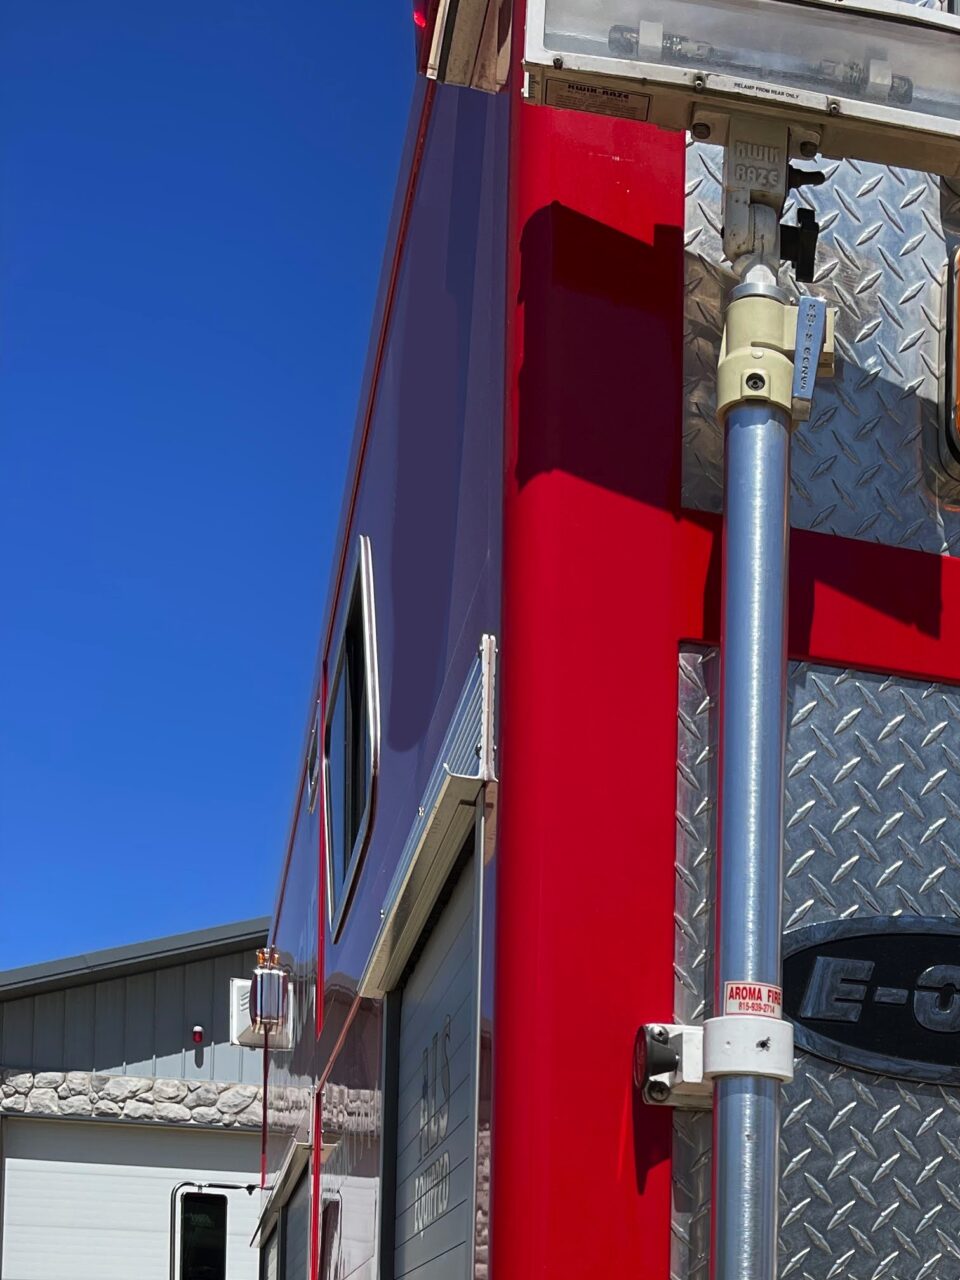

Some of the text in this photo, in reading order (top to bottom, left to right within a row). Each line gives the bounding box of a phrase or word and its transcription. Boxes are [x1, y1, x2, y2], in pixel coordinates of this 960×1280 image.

[735, 140, 780, 163] KWIK
[735, 163, 779, 187] RAZE
[728, 986, 763, 1001] AROMA
[418, 1014, 452, 1164] ALS
